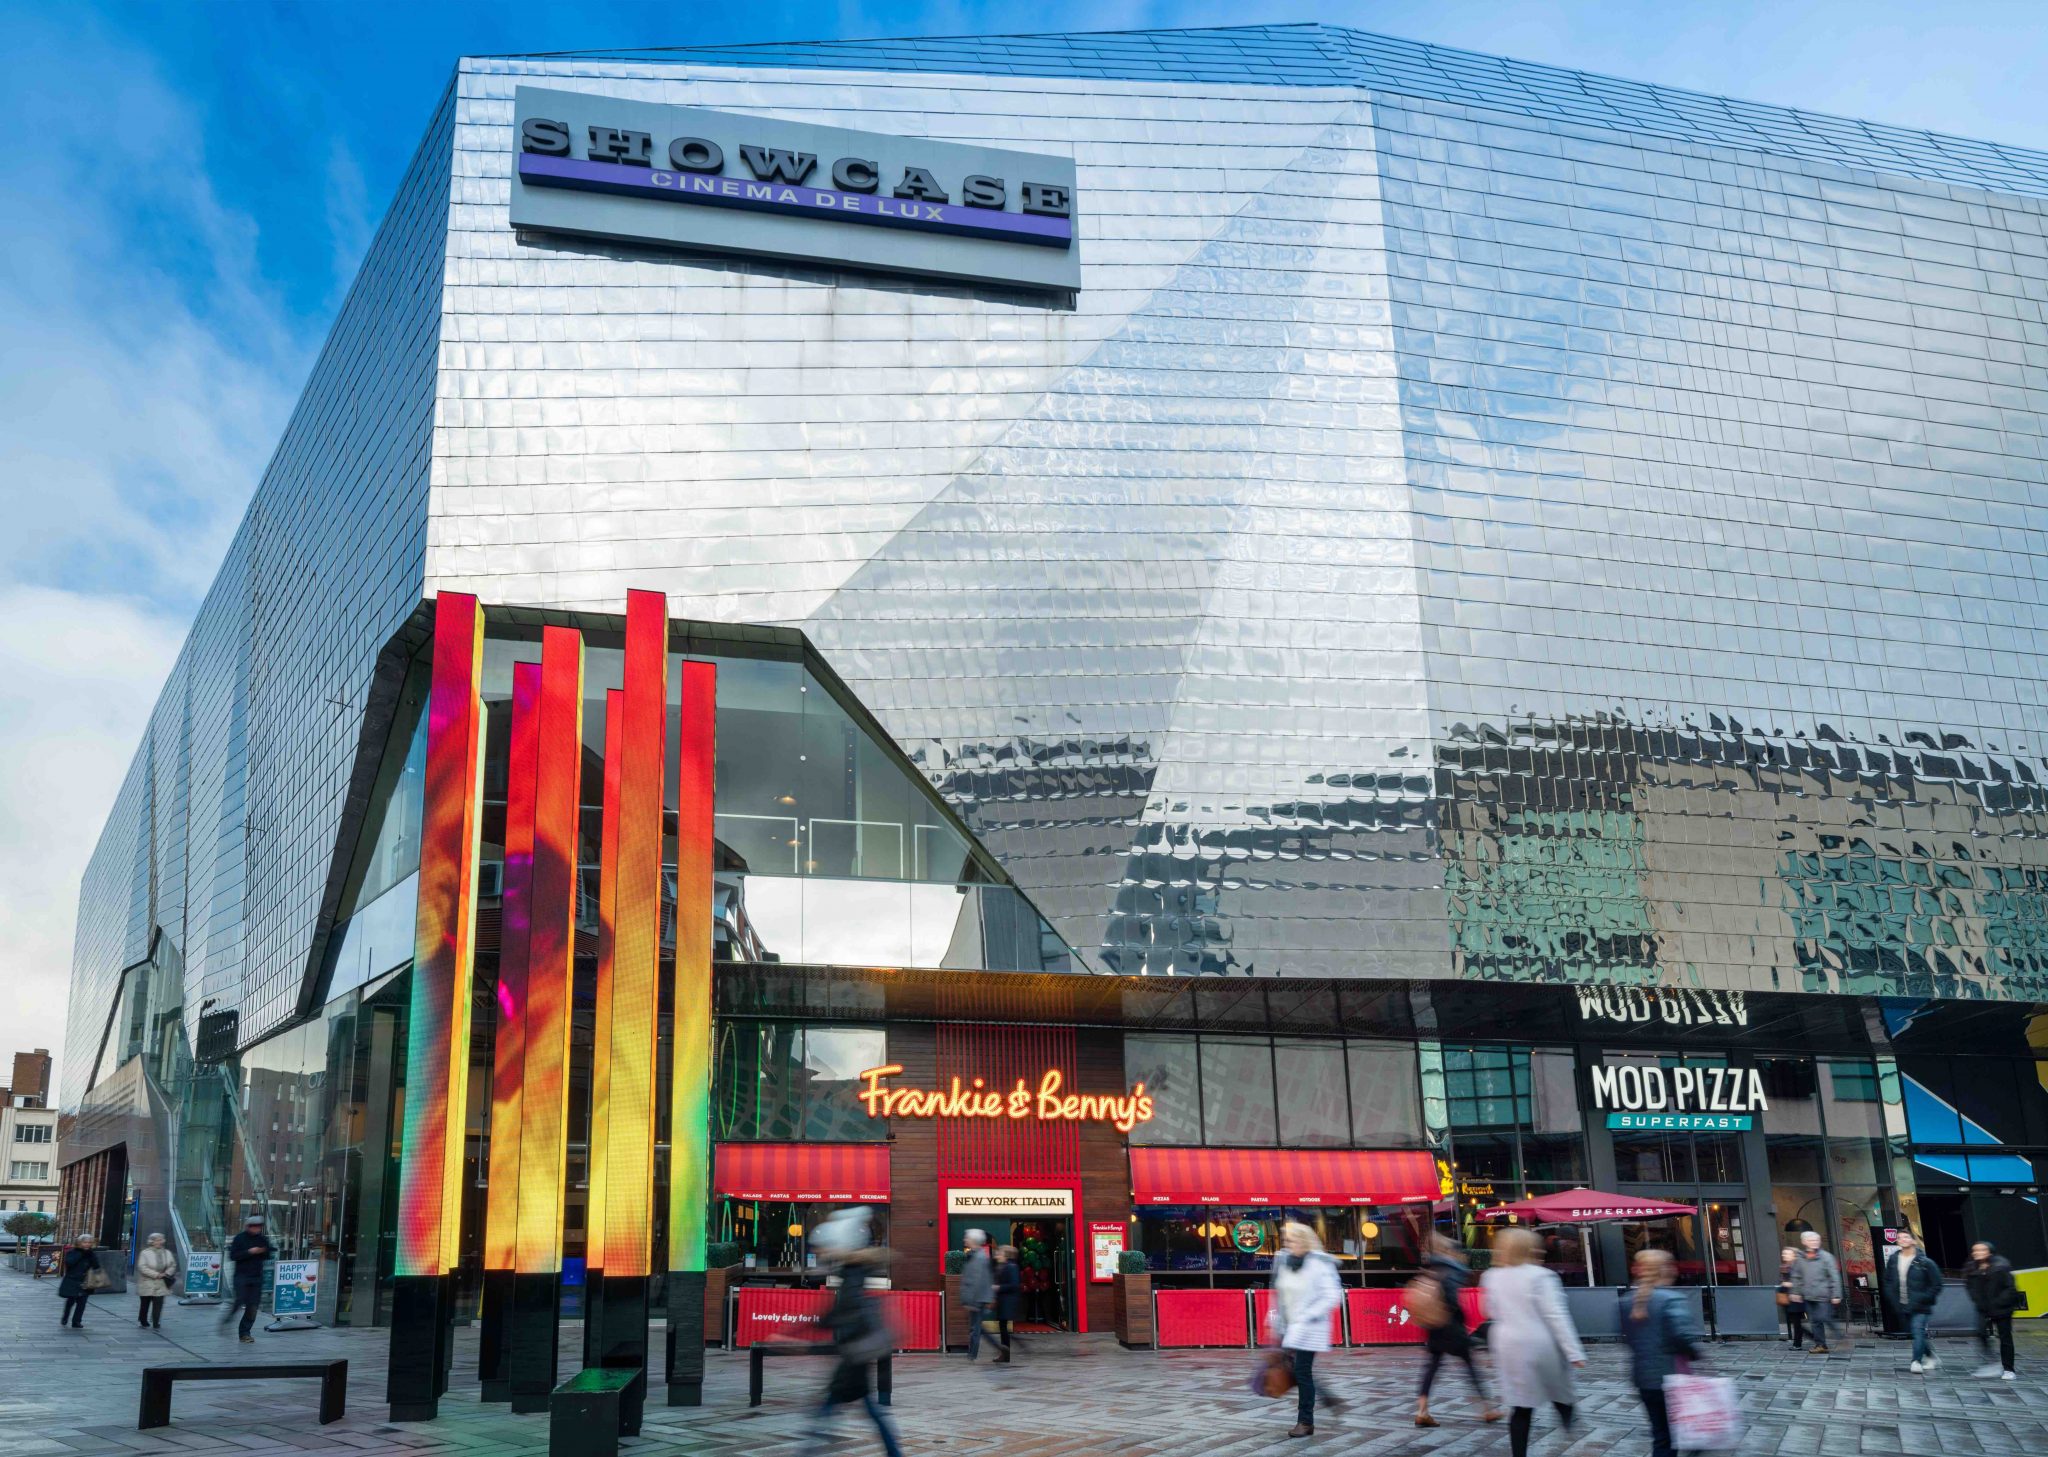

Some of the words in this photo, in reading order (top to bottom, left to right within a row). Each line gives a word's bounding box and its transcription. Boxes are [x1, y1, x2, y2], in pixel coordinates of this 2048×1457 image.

[522, 117, 1071, 218] SHOWCASE
[651, 172, 800, 204] CINEMA
[815, 193, 861, 211] DE
[878, 200, 945, 222] LUX
[1591, 1065, 1667, 1110] MOD
[1673, 1067, 1769, 1111] PIZZA
[859, 1064, 1004, 1119] Frankie
[1007, 1078, 1032, 1119] &
[1036, 1068, 1155, 1132] Benny's
[1621, 1116, 1744, 1128] SUPERFAST
[955, 1197, 982, 1206] NEW
[986, 1197, 1017, 1206] YORK
[1022, 1197, 1065, 1206] ITALIAN
[1572, 1208, 1664, 1216] SUPERFAST
[1886, 1231, 1897, 1239] MOD
[280, 1264, 307, 1273] HAPPY
[279, 1272, 302, 1280] HOUR
[752, 1312, 780, 1323] Lovely
[782, 1314, 797, 1323] day
[799, 1314, 811, 1322] for
